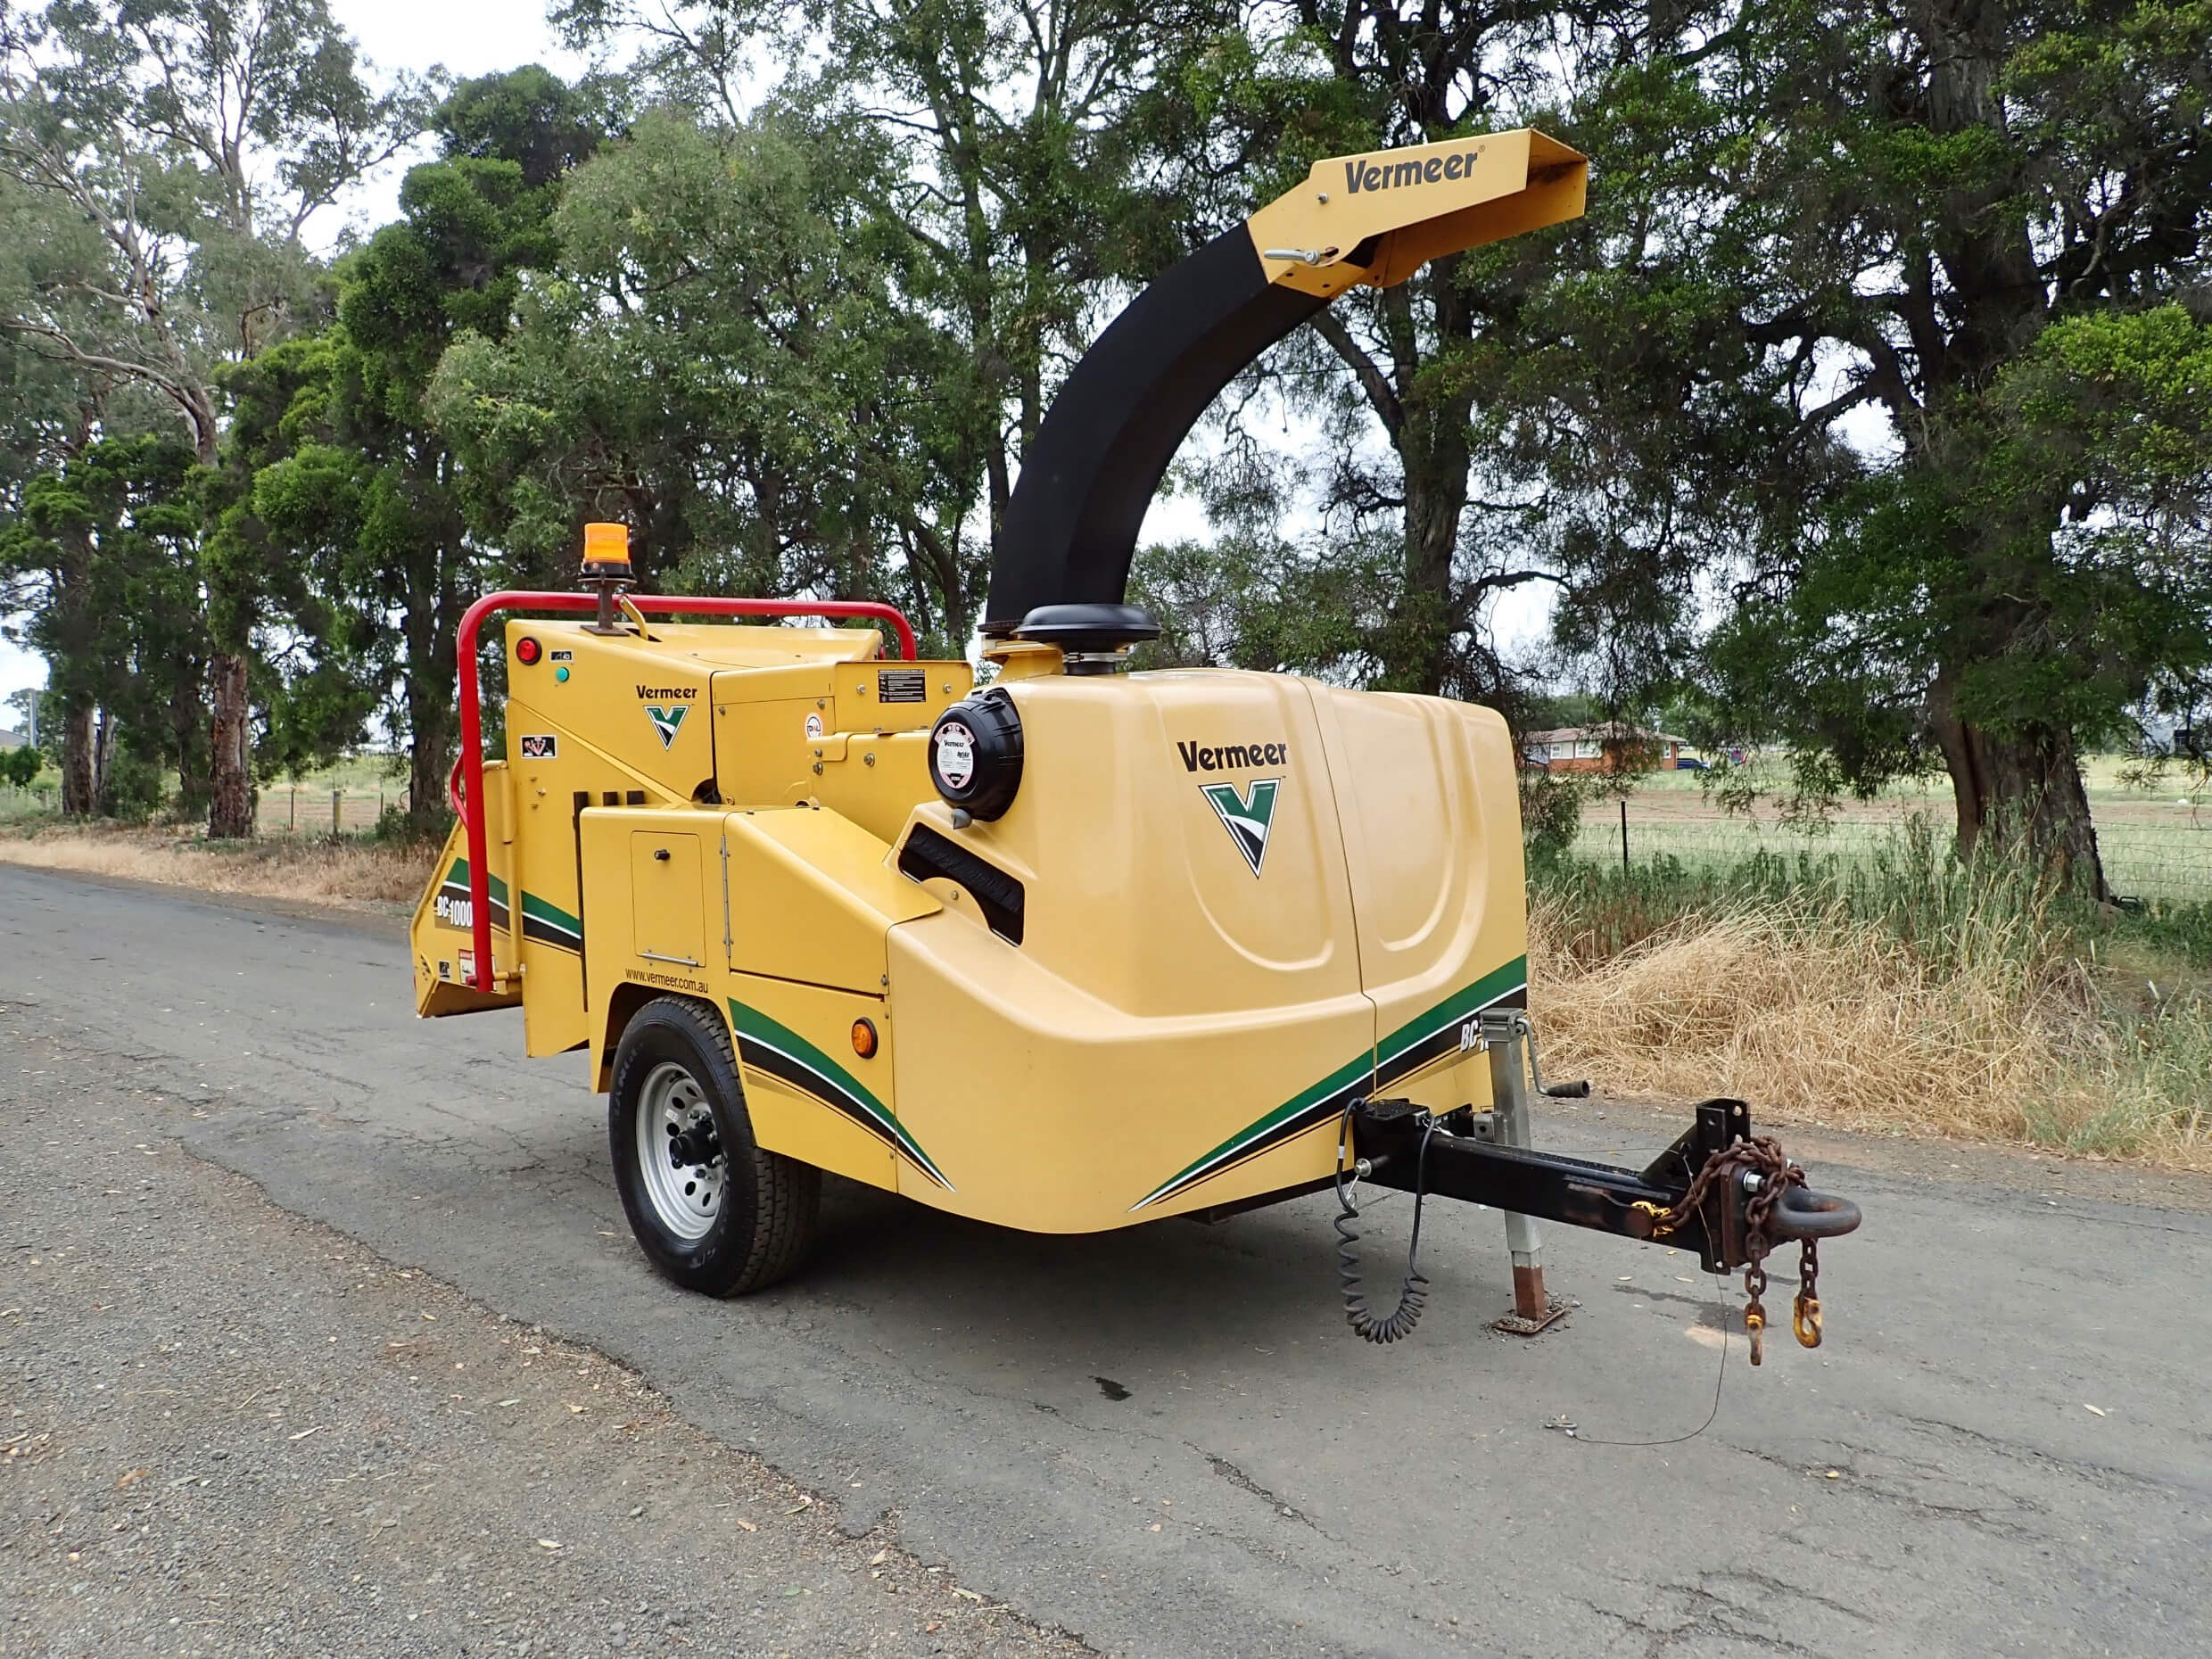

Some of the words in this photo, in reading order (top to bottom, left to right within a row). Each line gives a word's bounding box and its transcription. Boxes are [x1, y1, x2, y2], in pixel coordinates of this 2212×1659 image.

[1345, 152, 1478, 194] Vermeer
[636, 684, 697, 699] Vermeer
[1176, 740, 1287, 772] Vermeer
[625, 968, 709, 994] www.vermeer.com.au
